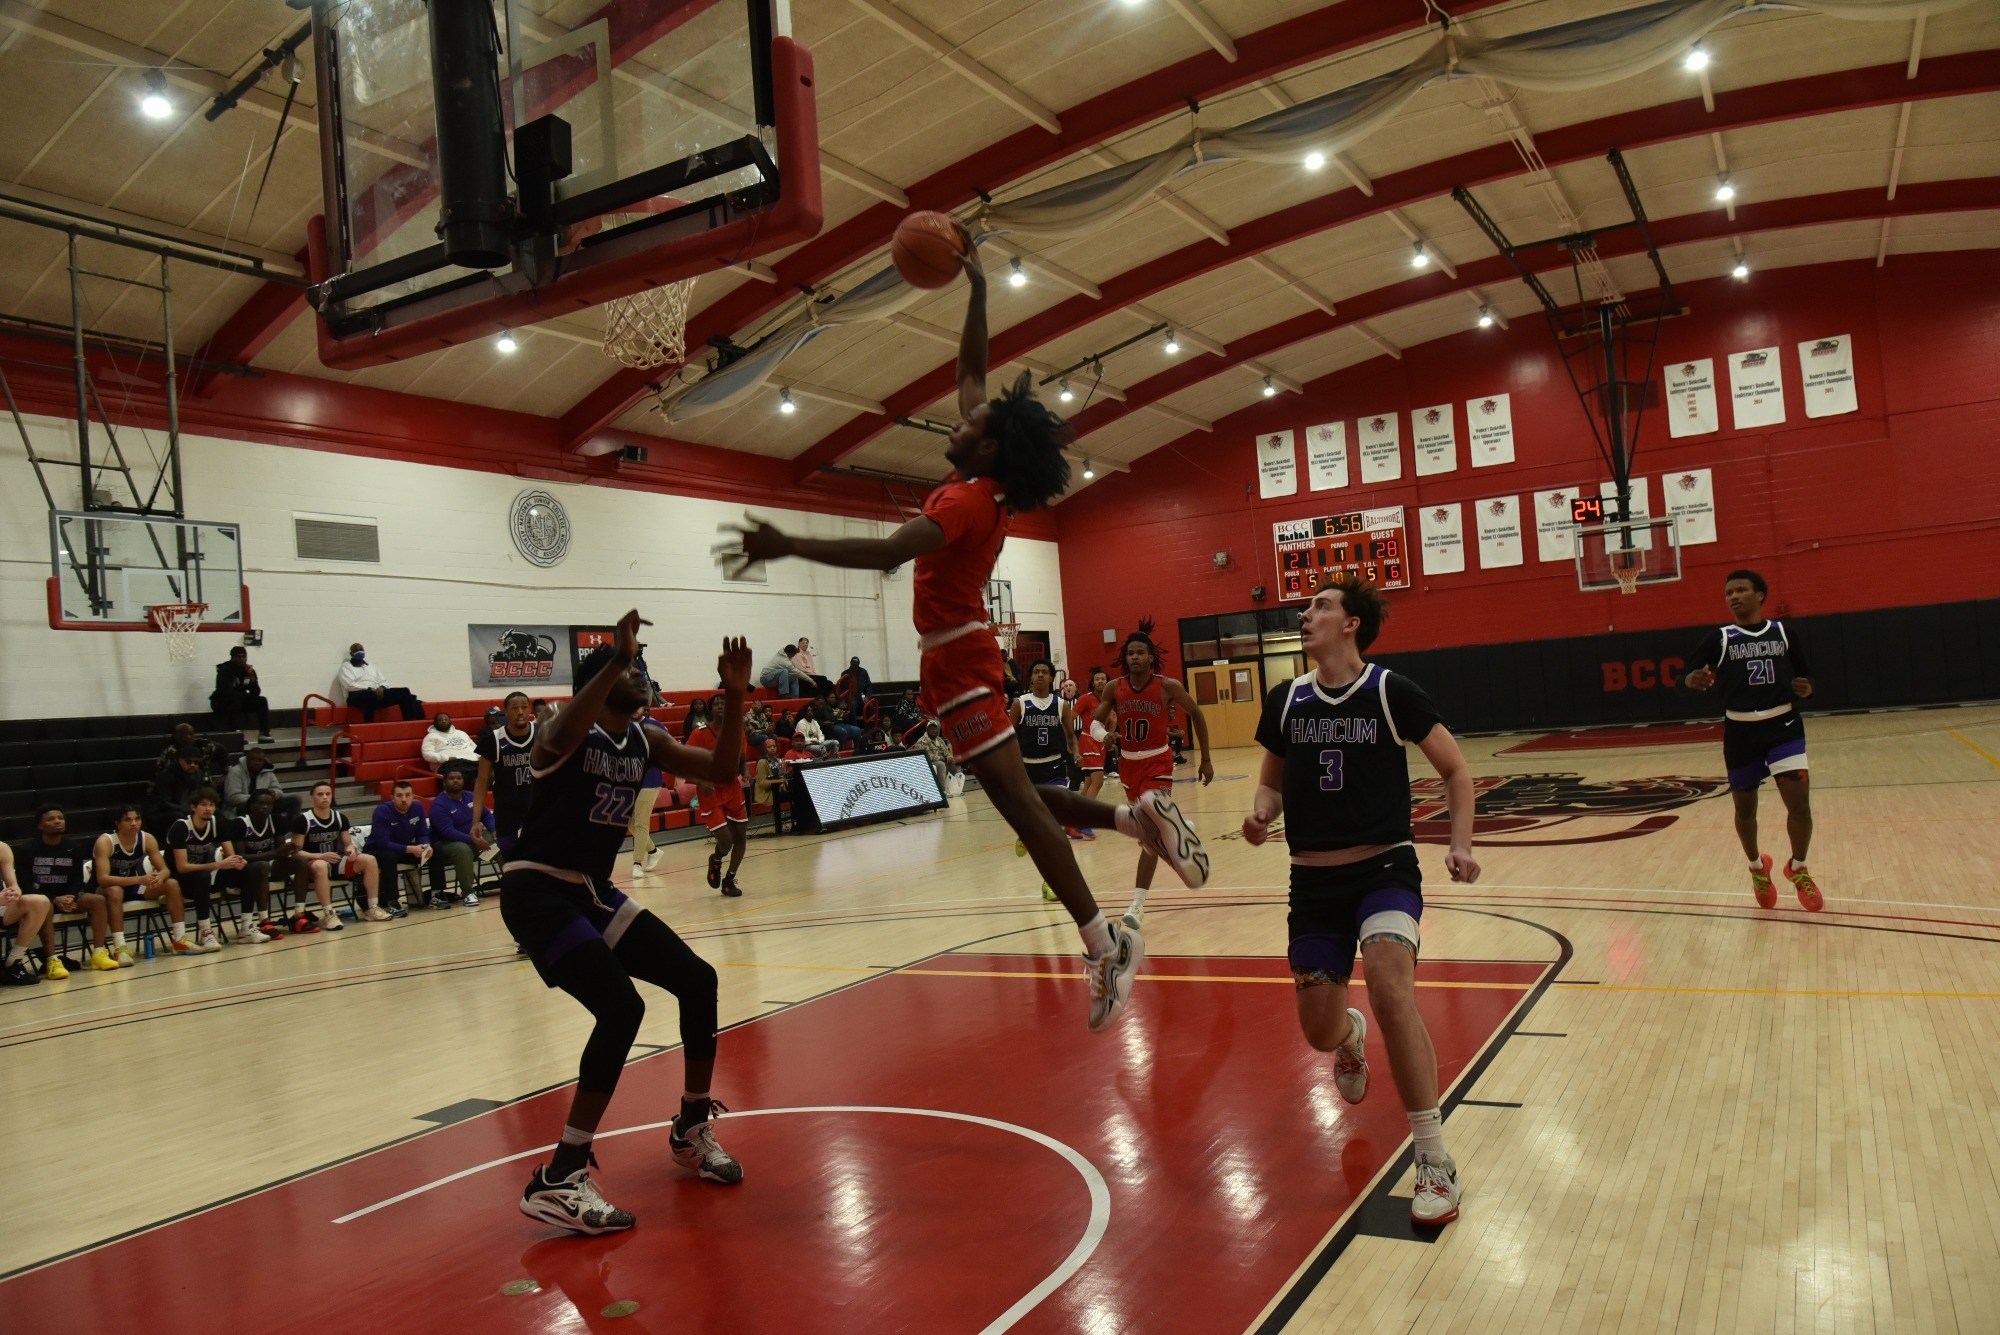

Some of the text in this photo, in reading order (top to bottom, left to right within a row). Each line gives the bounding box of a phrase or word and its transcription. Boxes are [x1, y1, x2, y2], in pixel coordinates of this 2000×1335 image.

[520, 502, 532, 526] NATIONAL
[552, 505, 565, 528] COLLEGE
[1574, 500, 1600, 520] 24
[1278, 522, 1308, 533] BCCC
[1325, 515, 1361, 534] 6:56
[1365, 511, 1401, 528] BALTIMORE
[520, 531, 565, 557] ATHLETIC ASSOCIATION
[1371, 530, 1395, 540] GUEST
[1278, 540, 1316, 552] PANTHERS
[1376, 540, 1398, 558] 28
[1290, 553, 1310, 569] 21
[1368, 568, 1376, 580] 5
[1391, 565, 1399, 578] 6
[1291, 577, 1299, 589] 6
[1309, 575, 1316, 588] 5
[1728, 641, 1785, 660] HARCUM
[490, 660, 553, 678] BCCC
[1747, 659, 1776, 686] 21
[1038, 728, 1048, 745] 5
[1125, 718, 1149, 742] 10
[1291, 718, 1377, 744] HARCUM
[503, 754, 530, 767] HARC
[516, 768, 531, 786] 14
[1319, 749, 1343, 791] 3
[870, 776, 897, 790] CITY
[589, 783, 635, 827] 22
